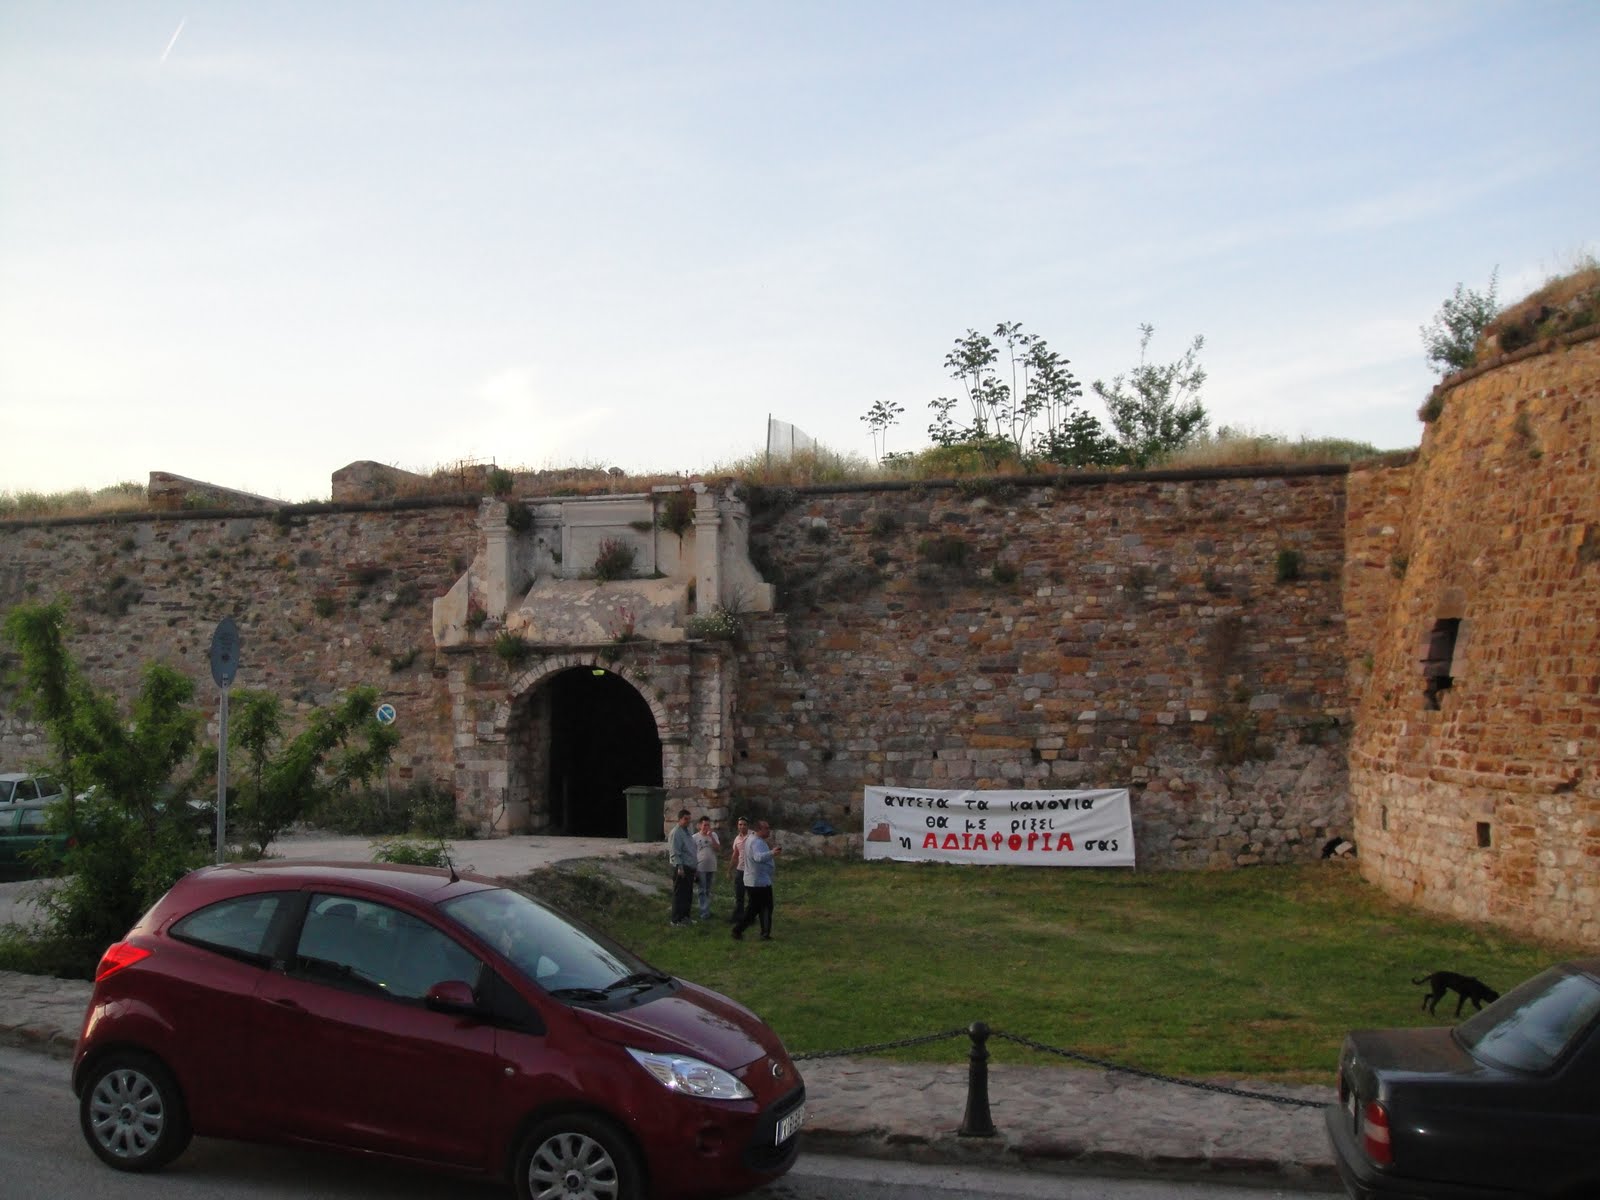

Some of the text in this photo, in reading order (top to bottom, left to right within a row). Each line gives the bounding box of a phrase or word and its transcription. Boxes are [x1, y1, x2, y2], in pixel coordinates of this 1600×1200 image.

[964, 799, 989, 810] τα
[925, 816, 949, 828] θα
[965, 818, 987, 832] με
[899, 831, 1119, 851] η ΑΔΙΑΦΟΡΙΑ σας
